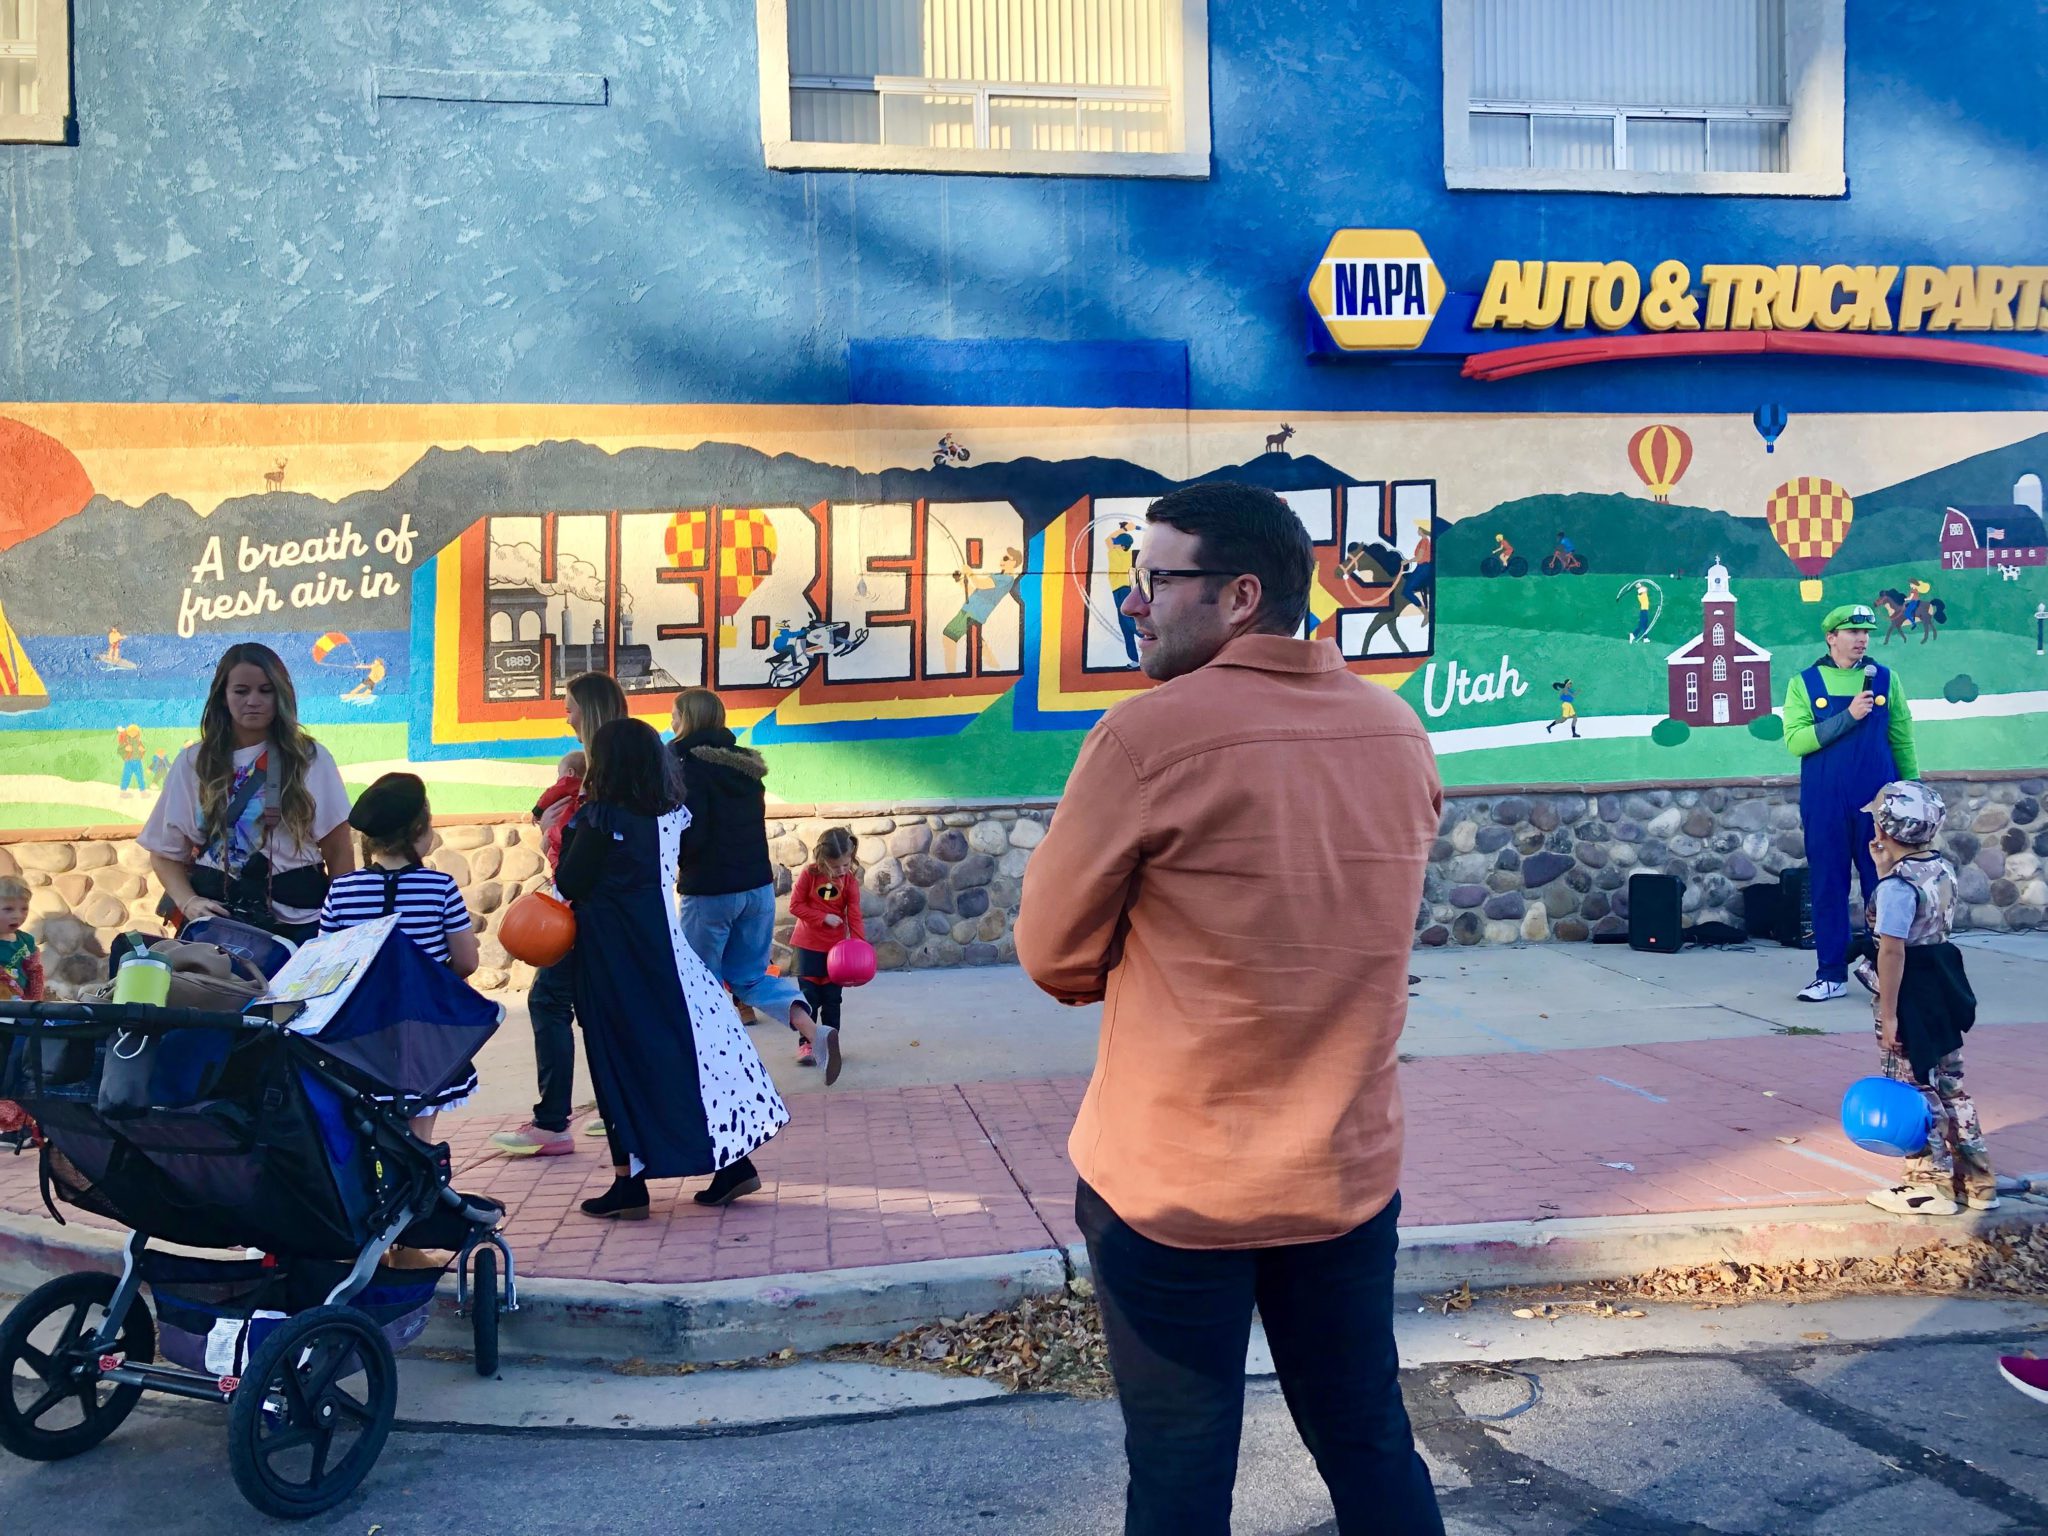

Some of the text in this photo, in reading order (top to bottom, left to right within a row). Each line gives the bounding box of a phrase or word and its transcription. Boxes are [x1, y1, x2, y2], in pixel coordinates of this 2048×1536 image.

[1334, 262, 1426, 316] NAPA
[1472, 259, 1641, 330] AUTO
[1641, 260, 1701, 331] &
[1700, 263, 1899, 331] TRUCK
[191, 513, 419, 584] A breath of
[177, 565, 401, 639] fresh air in
[484, 498, 1026, 704] HEBER
[504, 654, 532, 668] 1889
[1423, 654, 1529, 717] Utah
